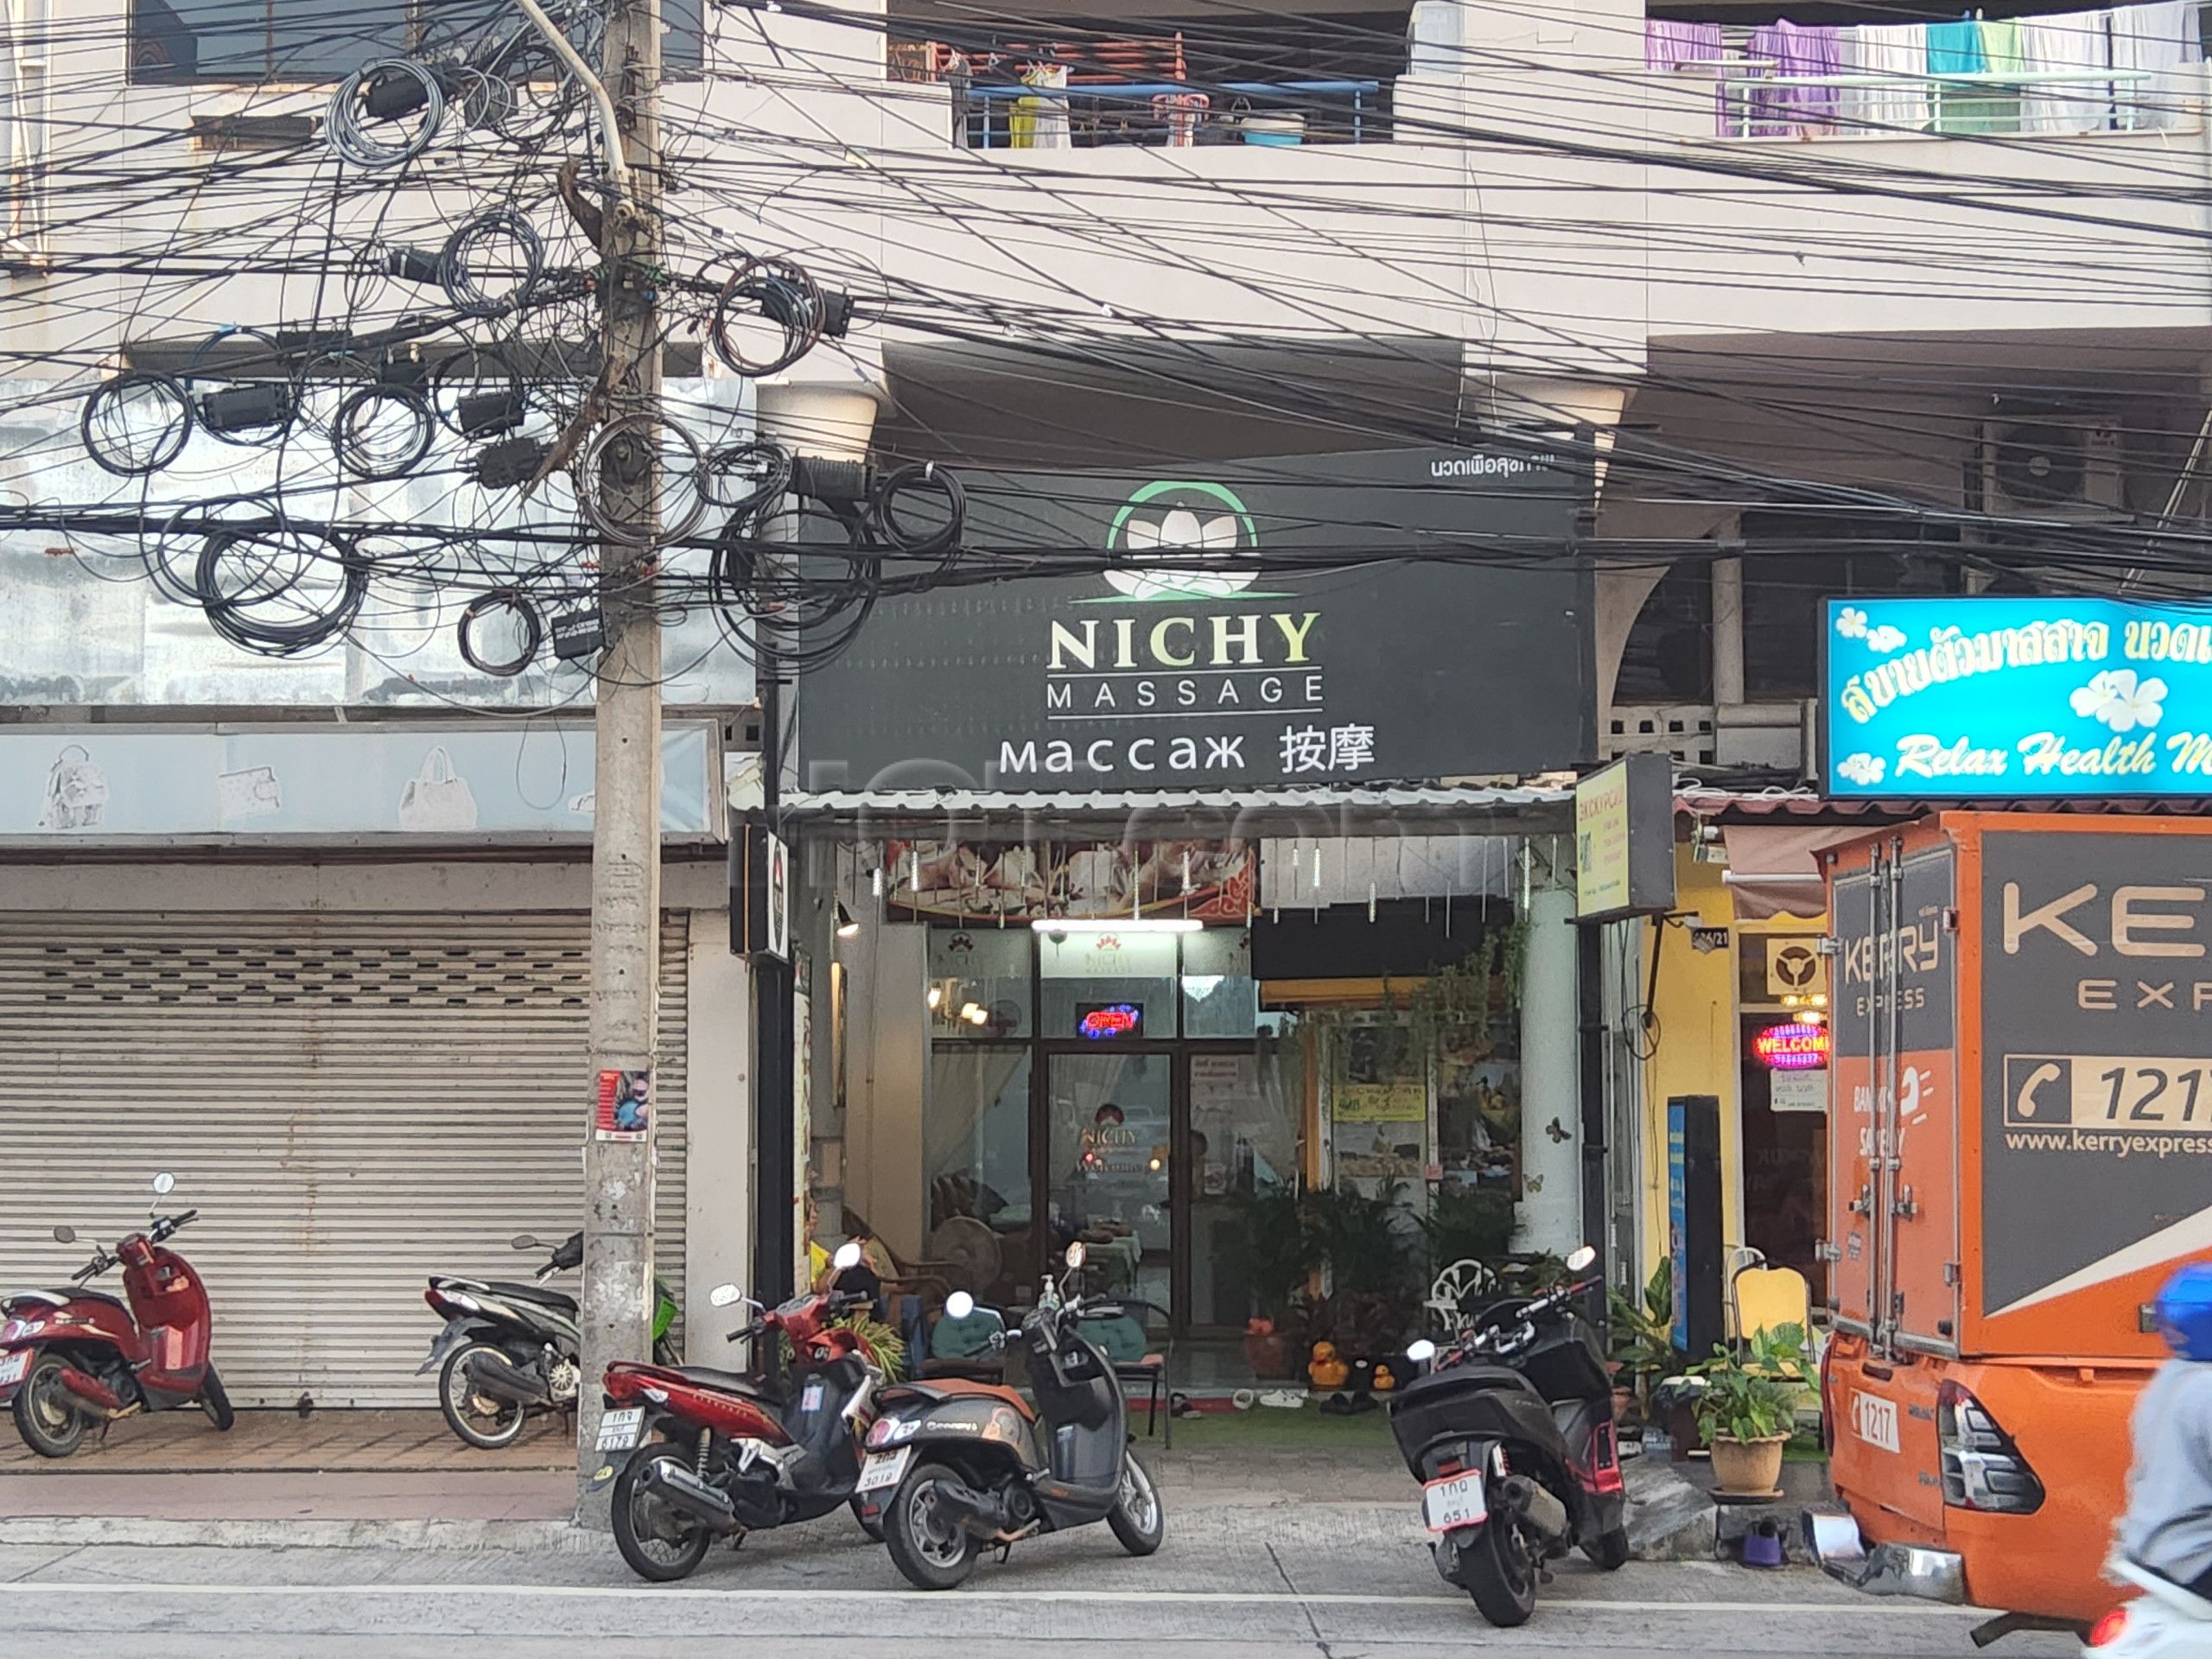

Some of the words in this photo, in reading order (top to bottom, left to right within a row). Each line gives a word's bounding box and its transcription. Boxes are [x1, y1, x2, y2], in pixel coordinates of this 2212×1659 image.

[1046, 612, 1322, 670] NICHY
[1046, 675, 1324, 709] MASSAGE
[1279, 723, 1376, 773] 按摩
[1895, 734, 2009, 779] Relax
[2017, 731, 2158, 776] Health
[2101, 1065, 2212, 1122] 121
[1865, 1401, 1891, 1445] 1217
[1443, 1508, 1470, 1523] 651
